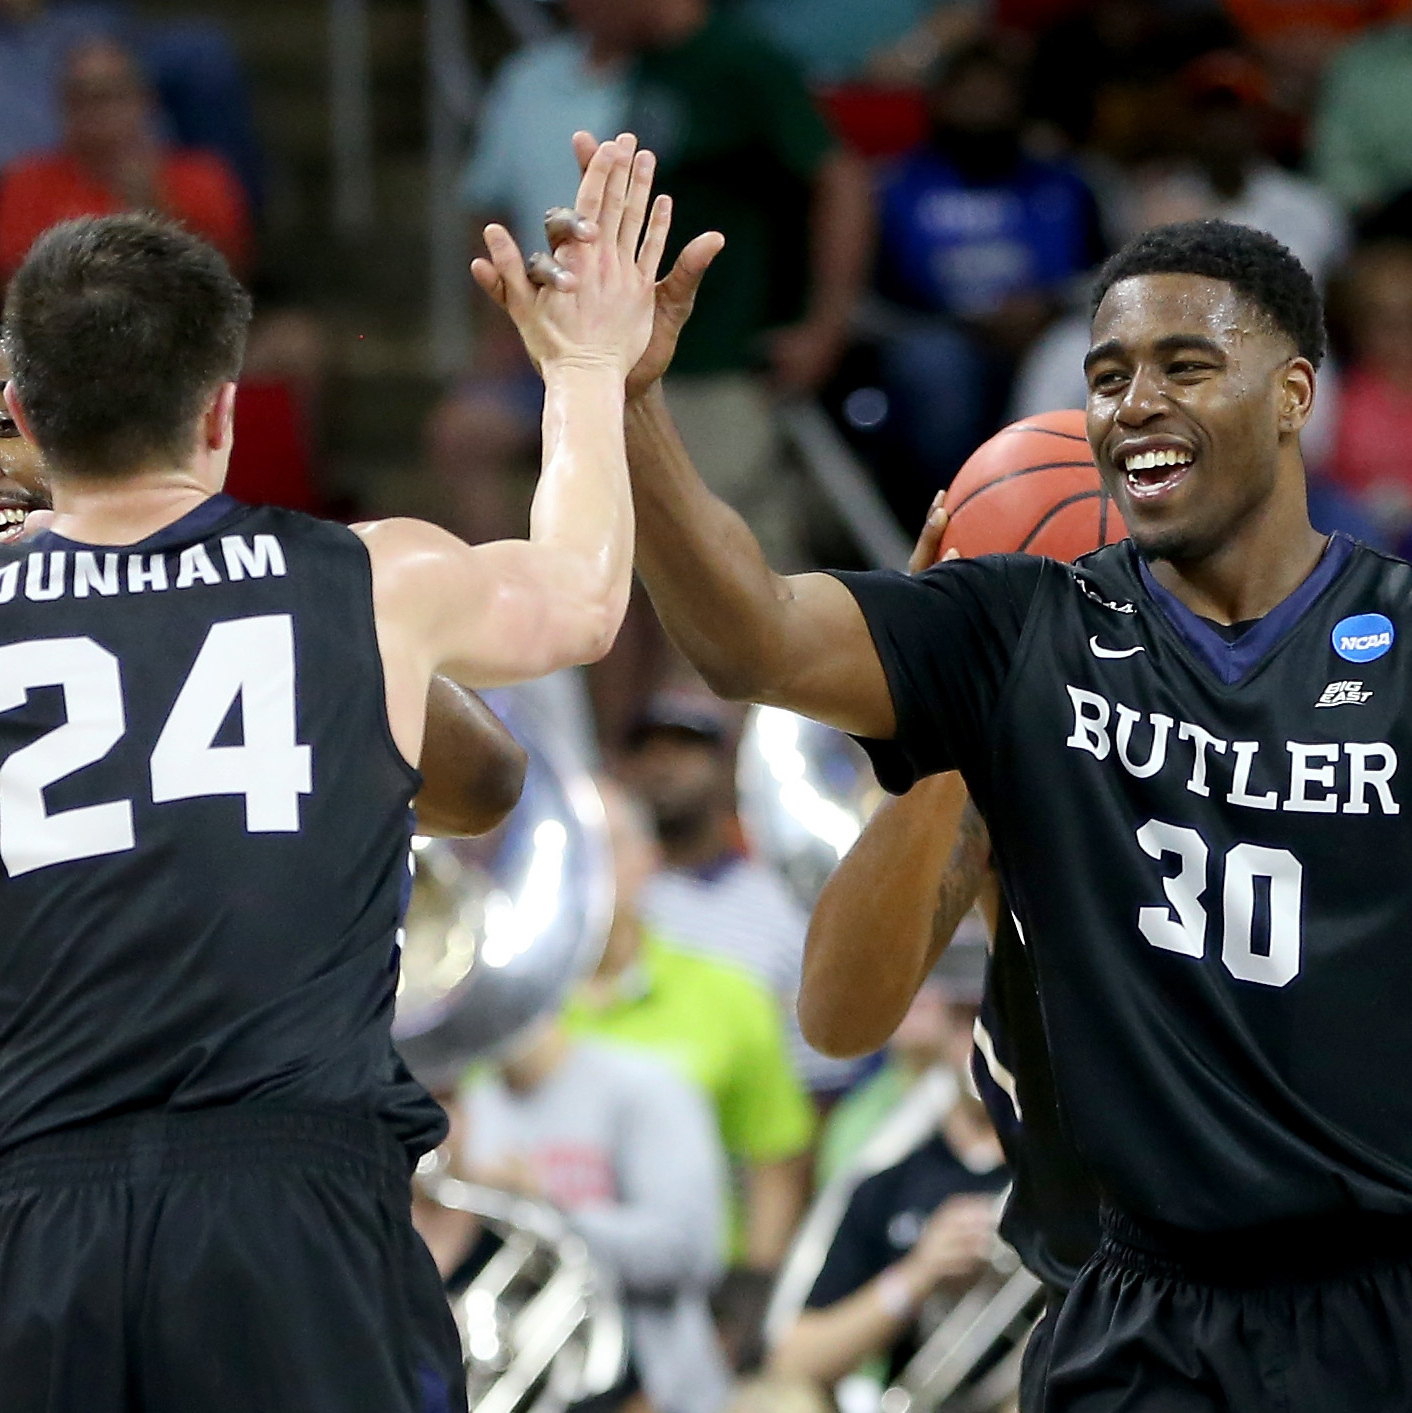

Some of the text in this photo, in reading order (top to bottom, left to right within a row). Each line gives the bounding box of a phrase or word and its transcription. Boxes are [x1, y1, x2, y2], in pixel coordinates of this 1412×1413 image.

[1340, 632, 1390, 650] NCAA
[1325, 681, 1363, 694] BIG
[1319, 691, 1374, 703] EAST
[1066, 684, 1400, 815] BUTLER
[1136, 818, 1303, 988] 30
